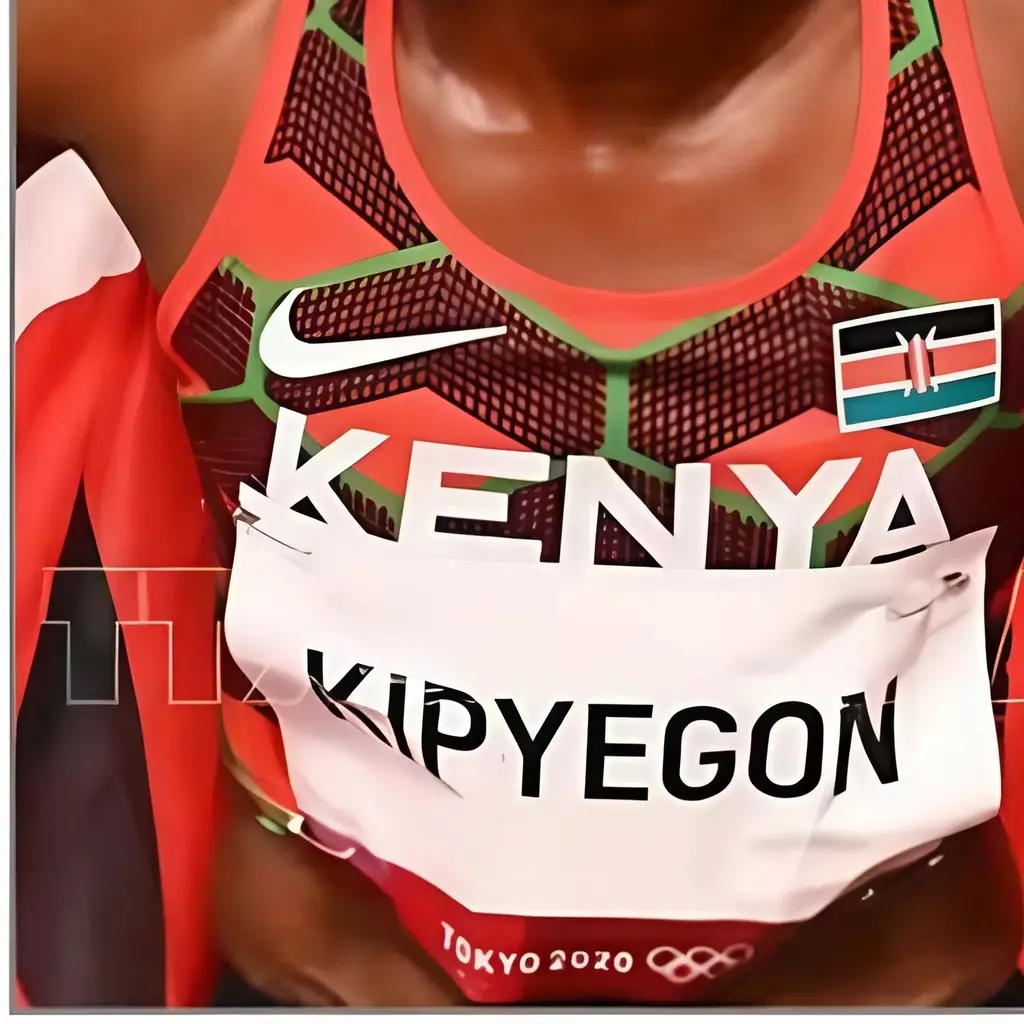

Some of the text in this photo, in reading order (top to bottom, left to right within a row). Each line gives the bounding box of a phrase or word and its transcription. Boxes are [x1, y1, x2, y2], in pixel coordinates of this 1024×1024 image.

[266, 406, 951, 570] KENYA
[306, 648, 900, 801] KIPYEGON
[441, 921, 541, 975] TOKYO
